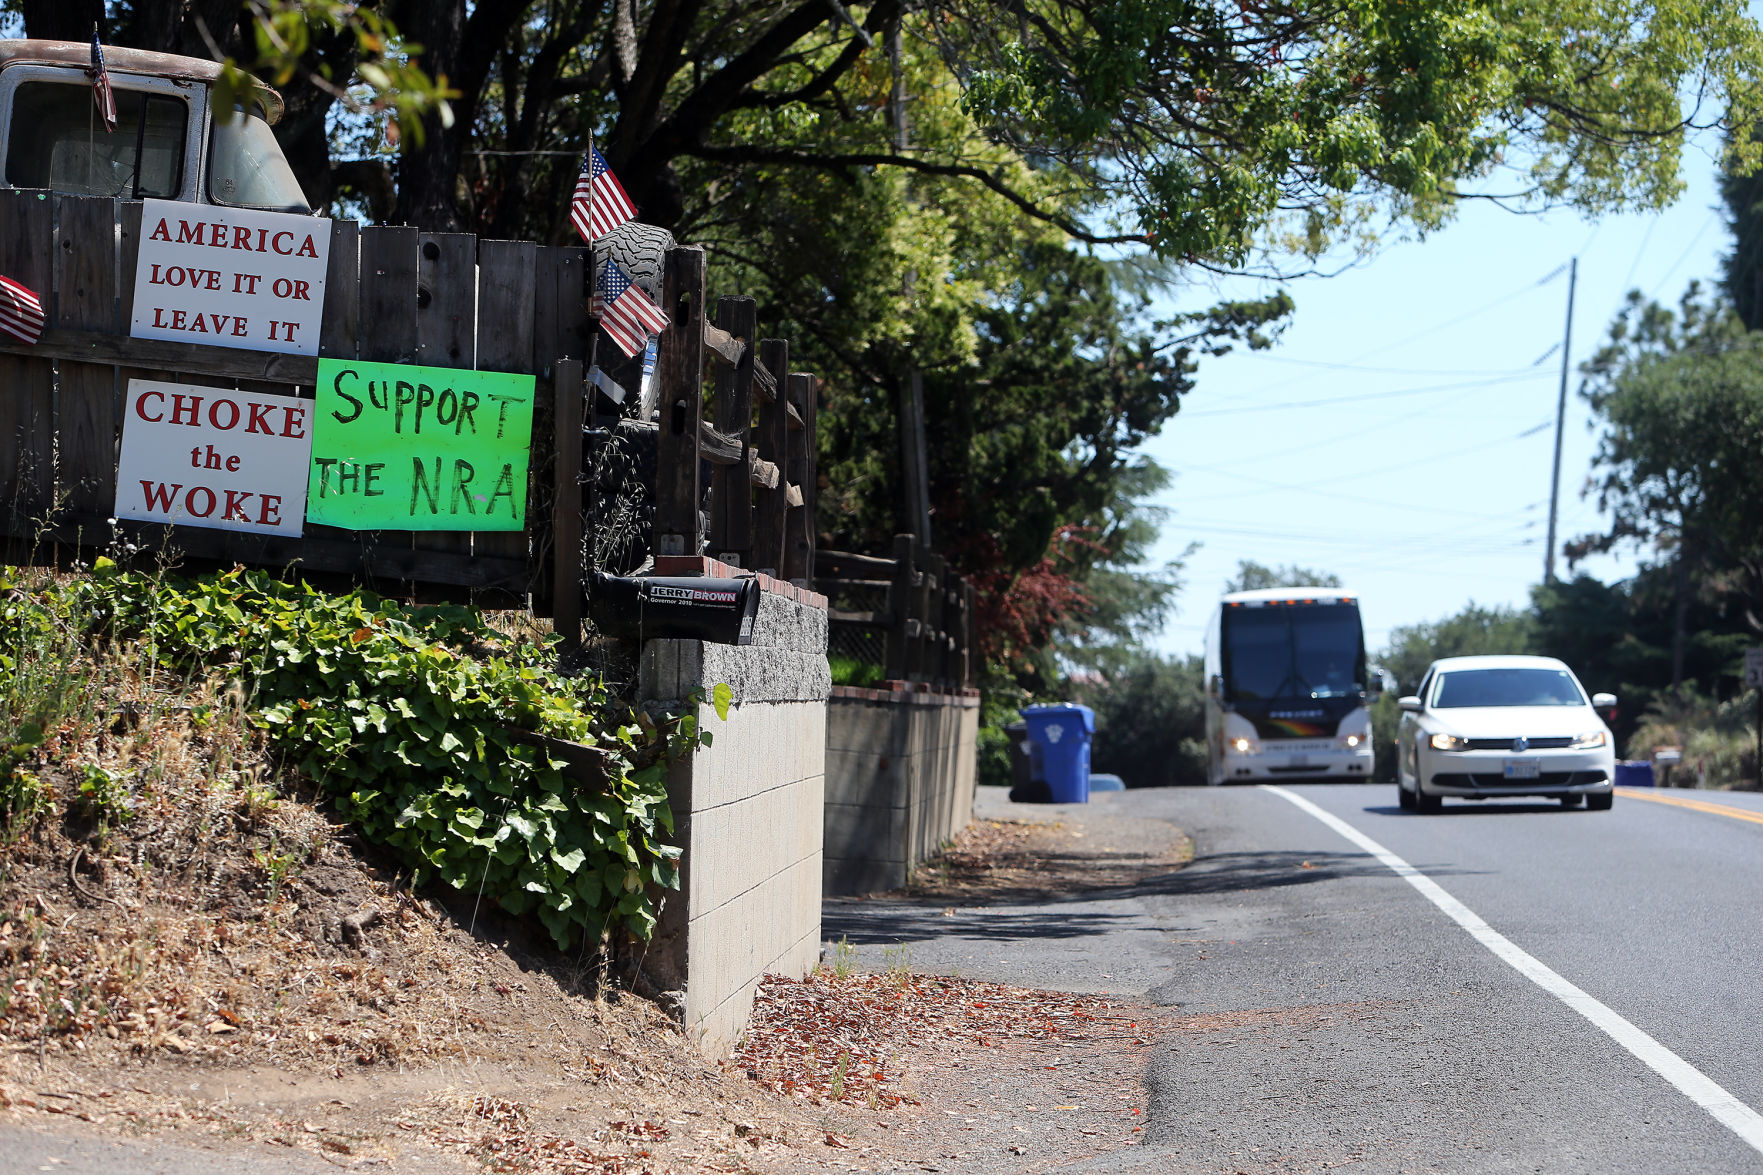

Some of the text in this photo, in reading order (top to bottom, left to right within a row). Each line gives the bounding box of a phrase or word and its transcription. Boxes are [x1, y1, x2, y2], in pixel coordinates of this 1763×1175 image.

[149, 217, 319, 258] AMERICA
[149, 264, 310, 301] LOVE IT OR
[152, 308, 300, 342] LEAVE IT
[135, 391, 306, 439] CHOKE
[190, 445, 241, 472] the
[139, 480, 282, 526] WOKE
[314, 456, 517, 520] THE NRA
[651, 587, 736, 602] JERRY BROWN
